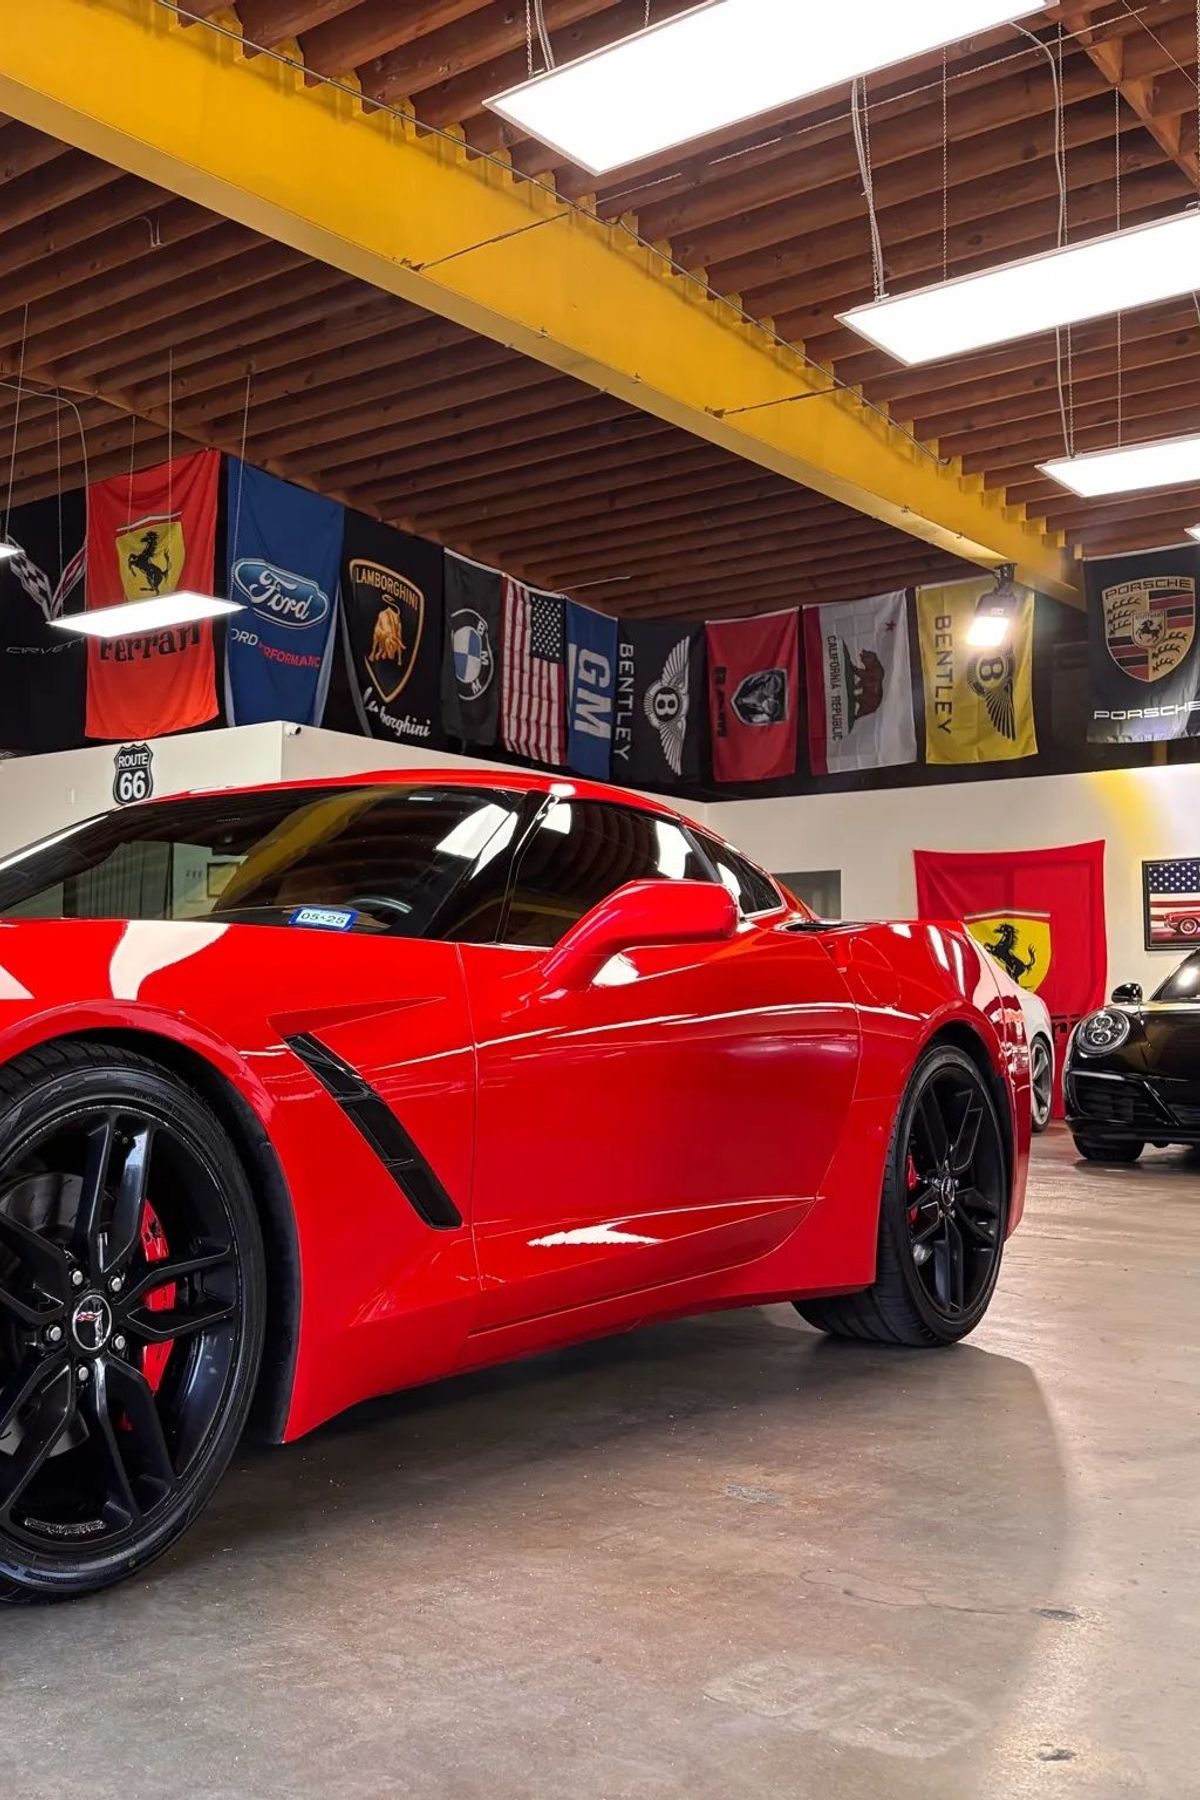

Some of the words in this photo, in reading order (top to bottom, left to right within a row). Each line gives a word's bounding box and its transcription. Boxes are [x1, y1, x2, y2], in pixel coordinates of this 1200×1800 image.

[249, 570, 314, 620] Ford
[356, 567, 419, 610] LAMBORGHINI
[1105, 579, 1191, 599] PORSCHE
[828, 635, 842, 690] CALIFORNIA
[934, 615, 953, 735] BENTLEY
[574, 648, 612, 739] GM
[613, 643, 635, 761] BENTLEY
[1093, 700, 1200, 720] PORSCHE
[831, 695, 843, 741] REPUBLIC
[118, 752, 148, 767] ROUTE
[120, 770, 146, 801] 66
